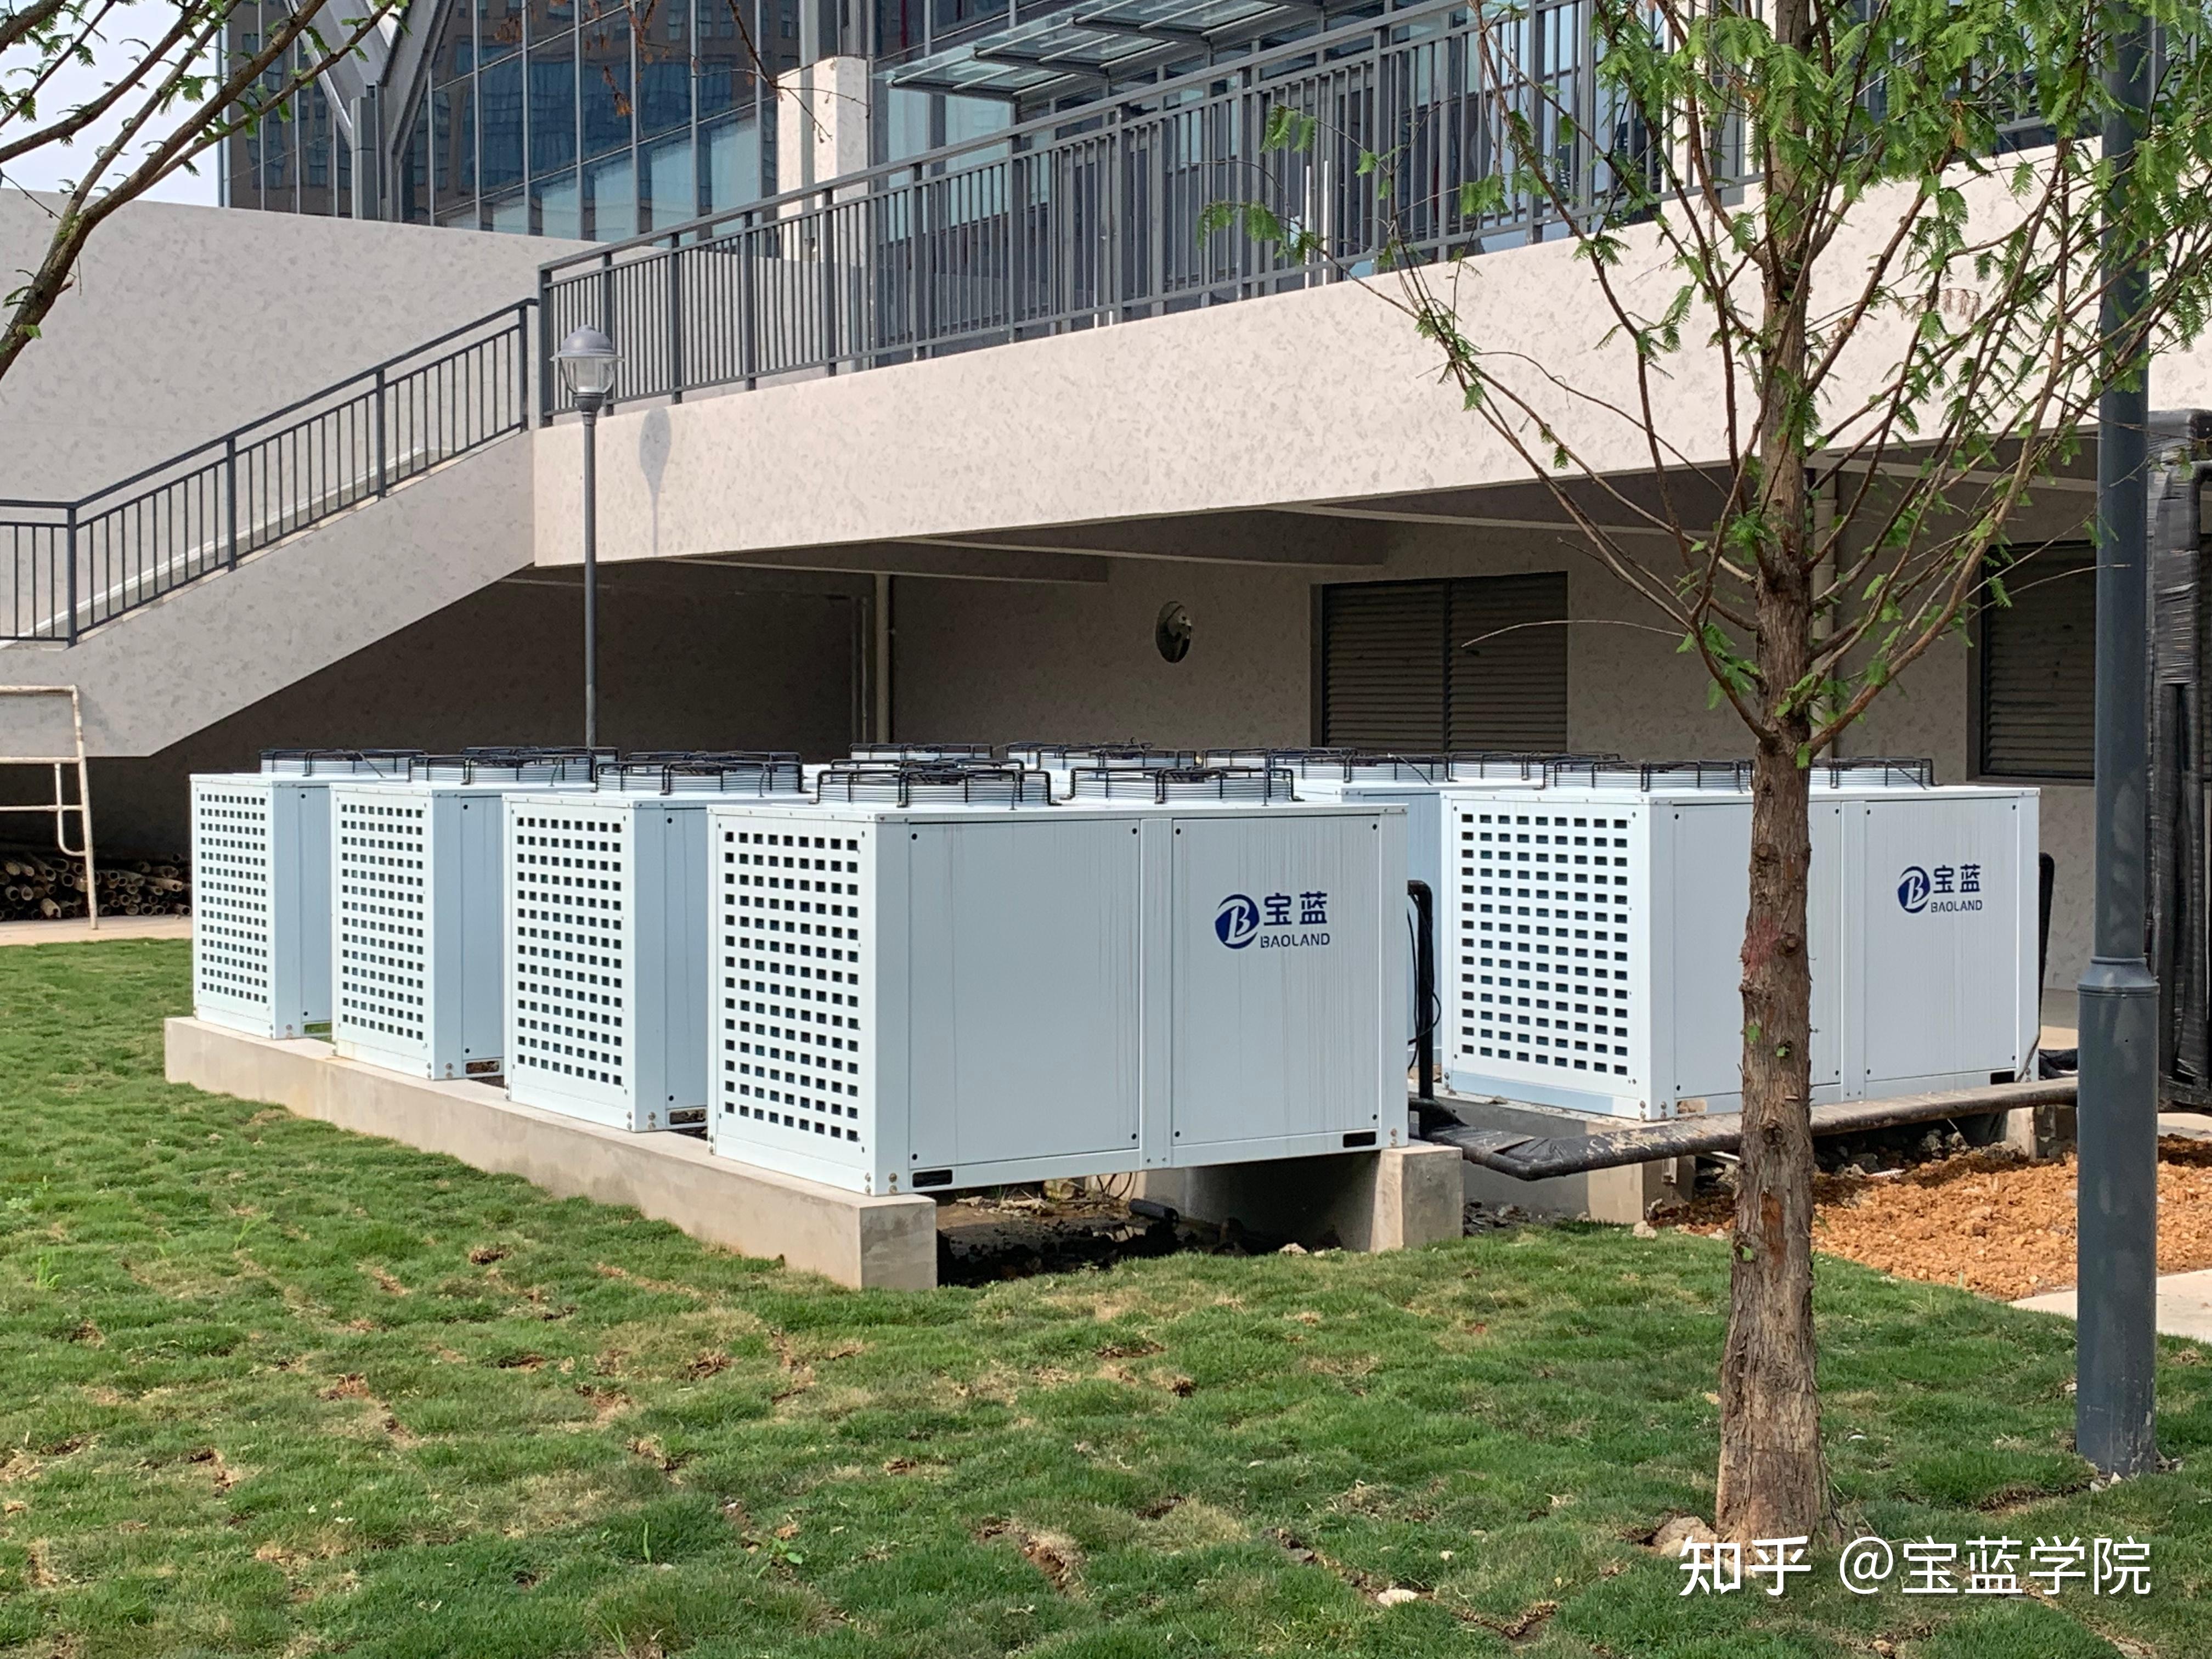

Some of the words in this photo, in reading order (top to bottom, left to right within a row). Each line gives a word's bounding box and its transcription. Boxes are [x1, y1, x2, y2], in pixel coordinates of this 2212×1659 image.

[1933, 864, 1981, 894] 宝蓝
[1263, 891, 1327, 926] 宝蓝
[1931, 900, 1983, 913] BAOLAND
[1261, 933, 1330, 948] BAOLAND
